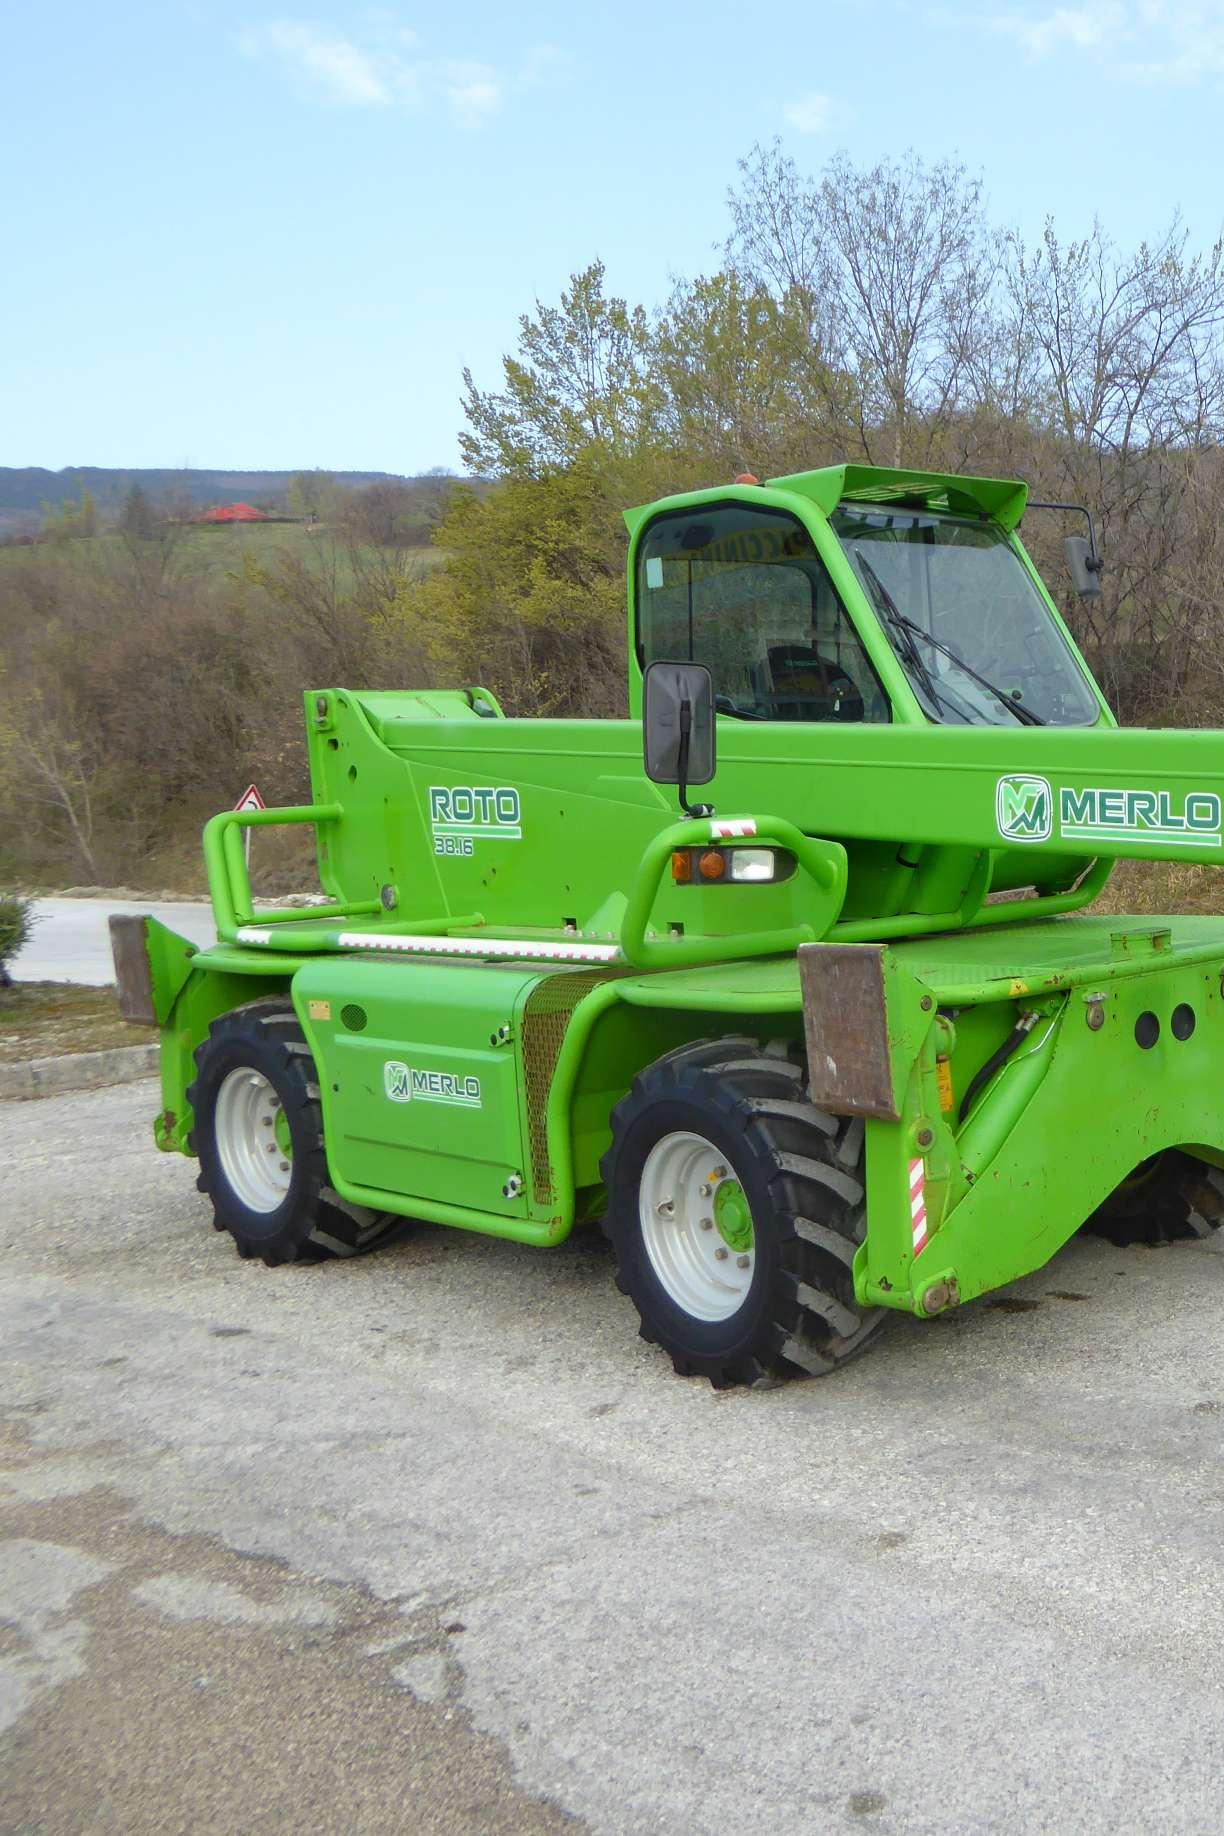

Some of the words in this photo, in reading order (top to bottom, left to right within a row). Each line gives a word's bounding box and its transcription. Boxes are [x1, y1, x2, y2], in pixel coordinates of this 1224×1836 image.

[430, 787, 520, 823] ROTO
[1060, 788, 1221, 831] MERLO
[434, 838, 473, 855] 38.16
[411, 1069, 480, 1099] MERLO
